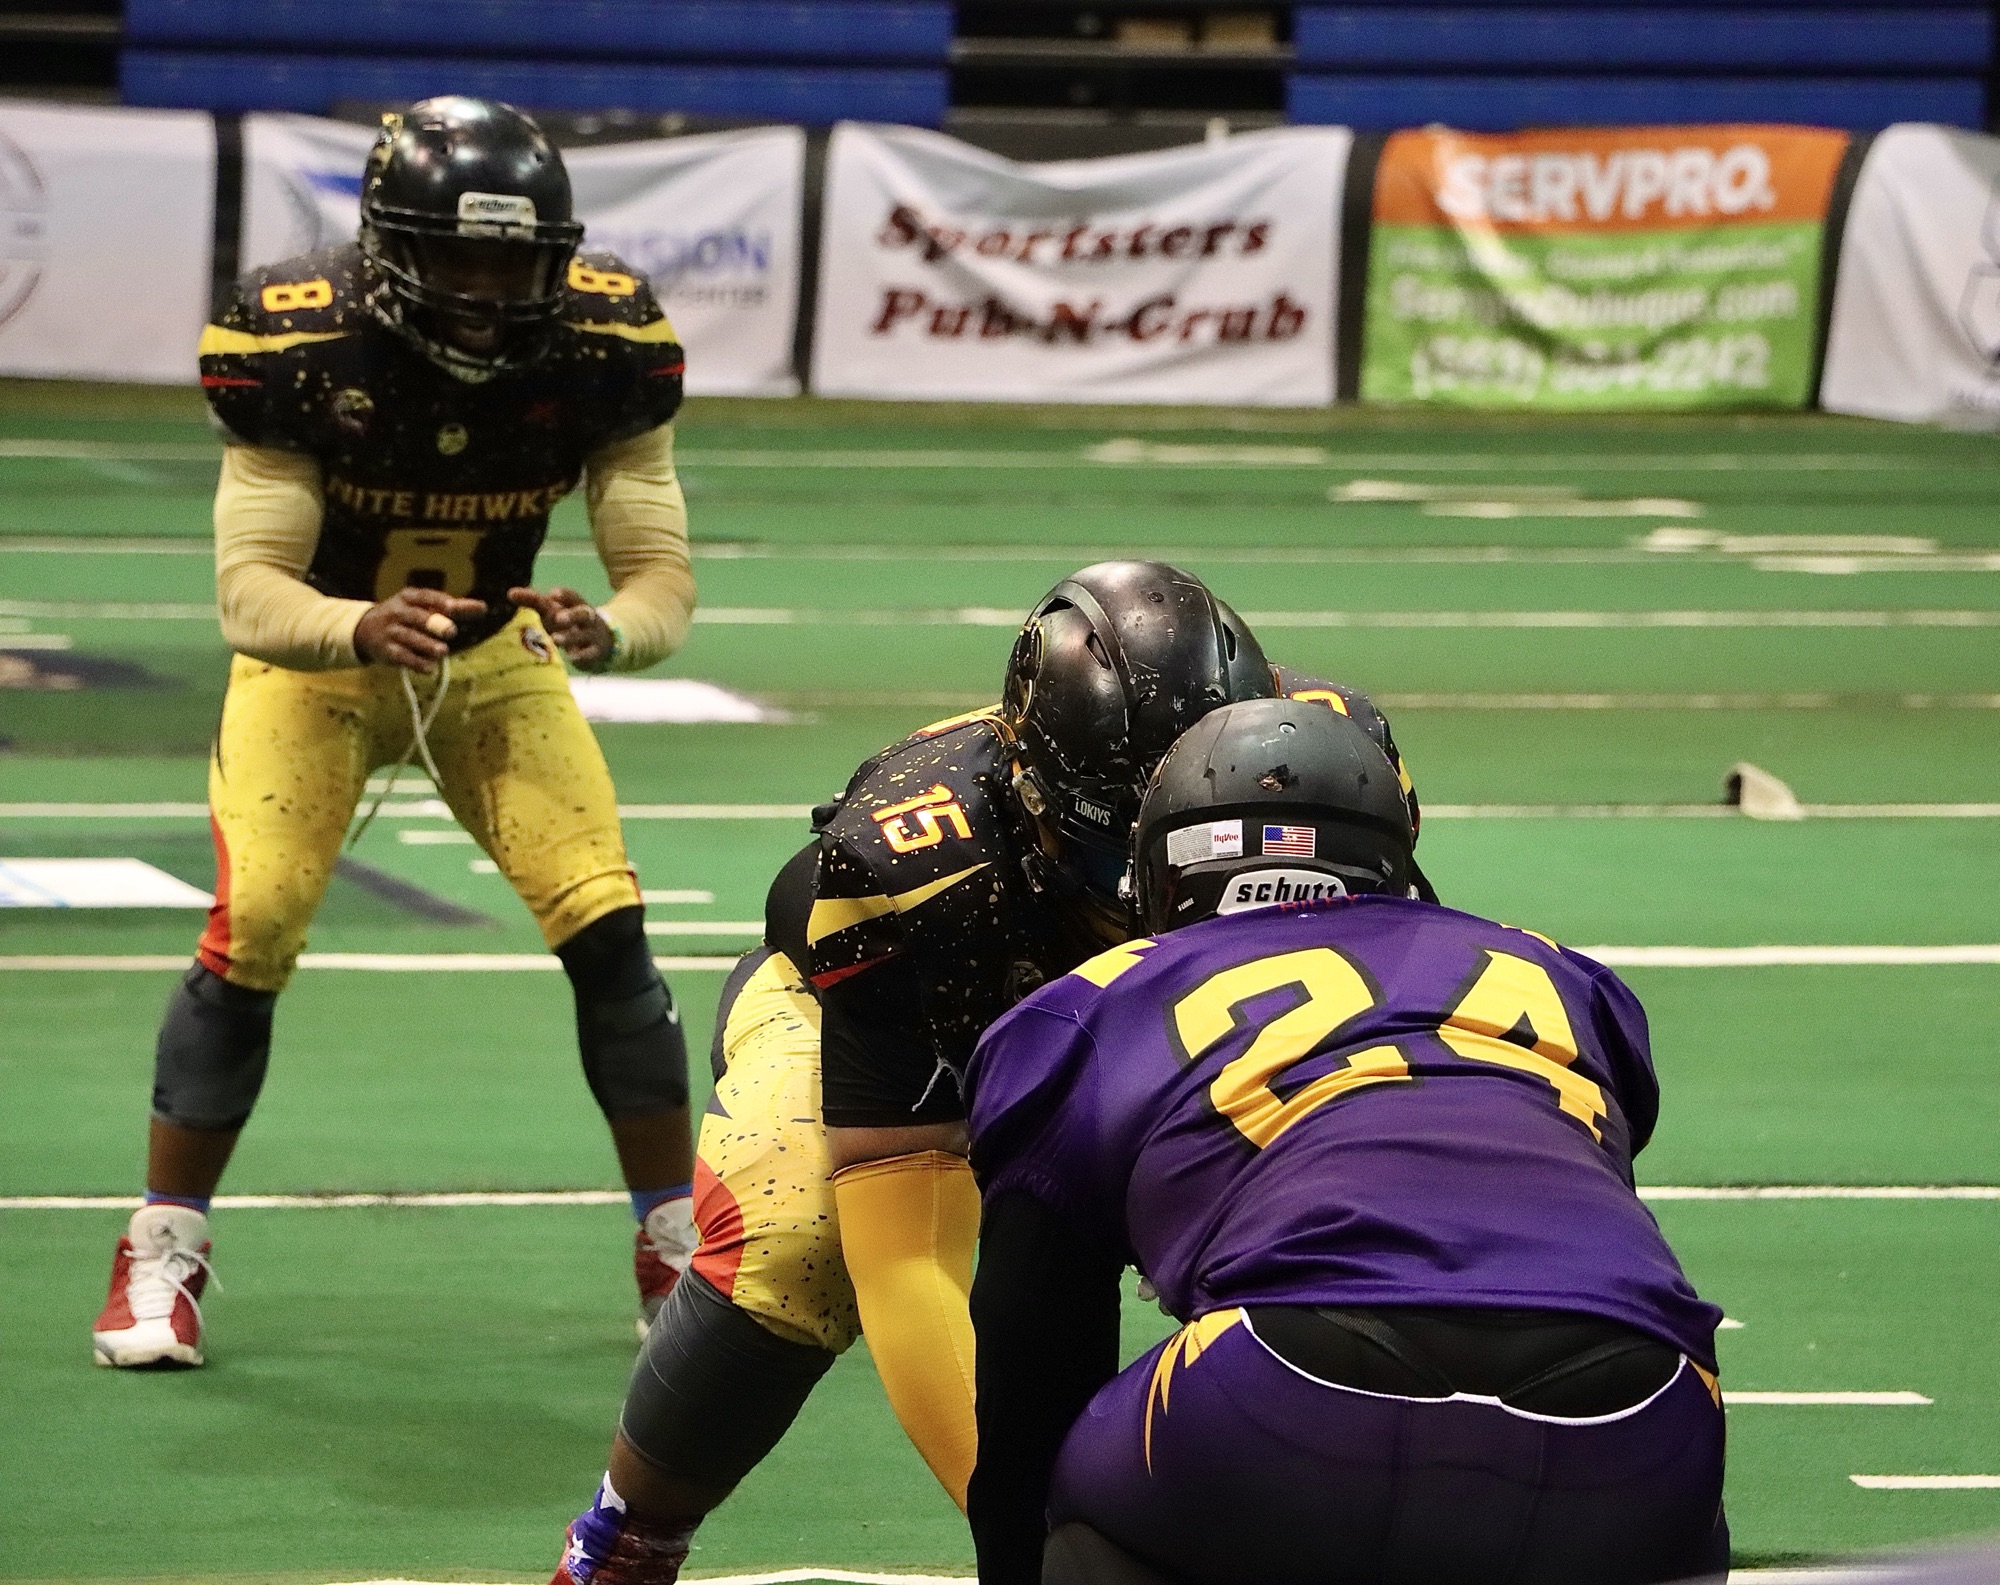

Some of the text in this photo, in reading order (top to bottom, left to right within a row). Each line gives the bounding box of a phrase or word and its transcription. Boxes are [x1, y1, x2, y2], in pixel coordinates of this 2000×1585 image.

[880, 205, 1269, 262] Sportsters
[261, 279, 333, 313] 8
[567, 256, 637, 296] 8
[327, 477, 411, 517] NITE
[374, 527, 487, 602] 8
[870, 783, 973, 853] 15
[1236, 876, 1338, 903] schutt
[1165, 946, 1608, 1150] 24
